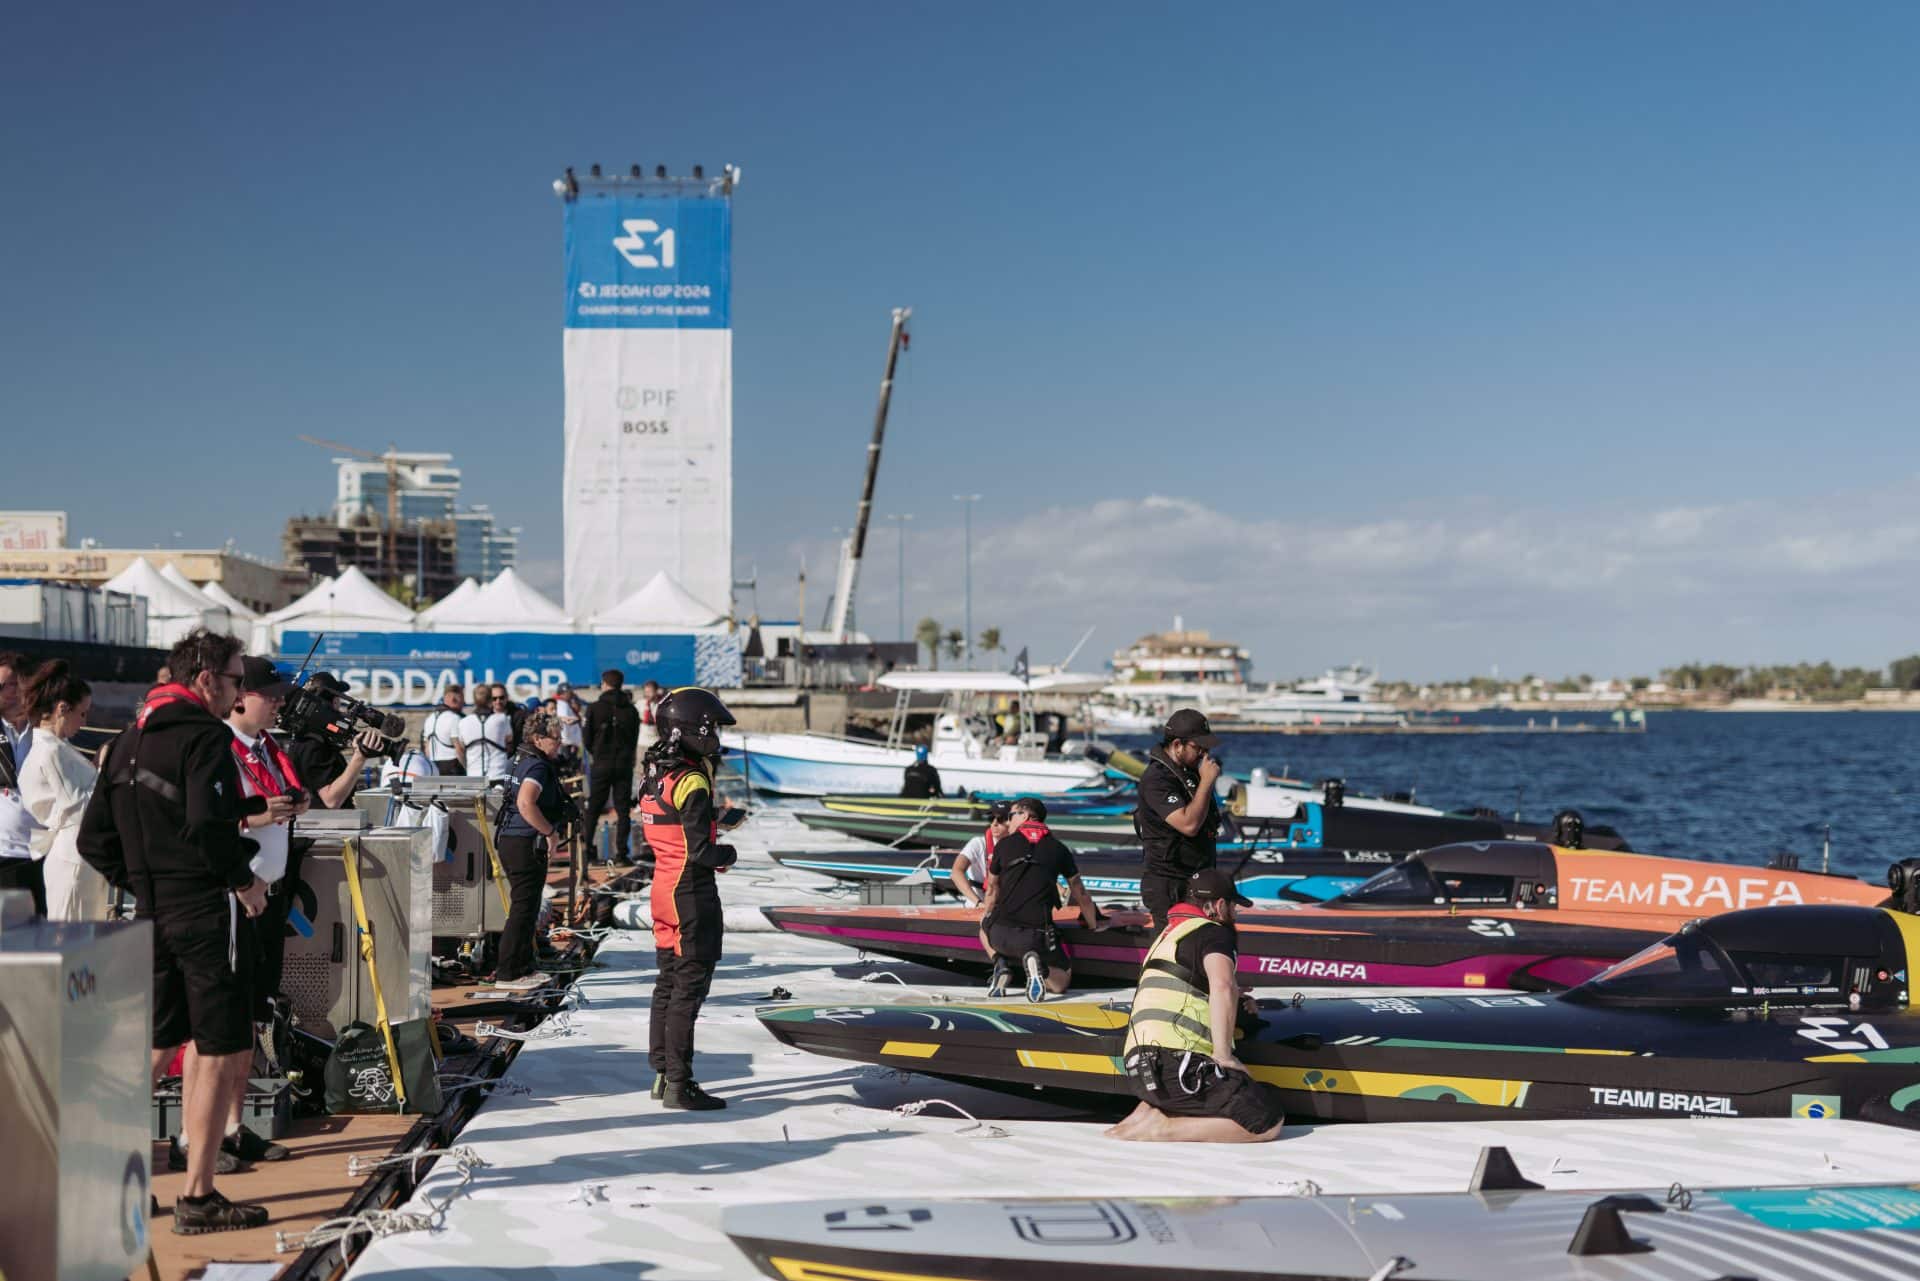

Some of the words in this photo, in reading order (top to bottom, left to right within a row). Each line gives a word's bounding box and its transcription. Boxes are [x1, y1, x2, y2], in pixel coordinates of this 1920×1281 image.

[599, 285, 650, 298] JEDDAH
[653, 285, 673, 298] GP
[674, 285, 710, 298] 2024
[642, 389, 677, 406] PIF
[623, 421, 669, 435] BOSS
[1589, 1087, 1654, 1107] TEAM
[1658, 1093, 1738, 1115] BRAZIL
